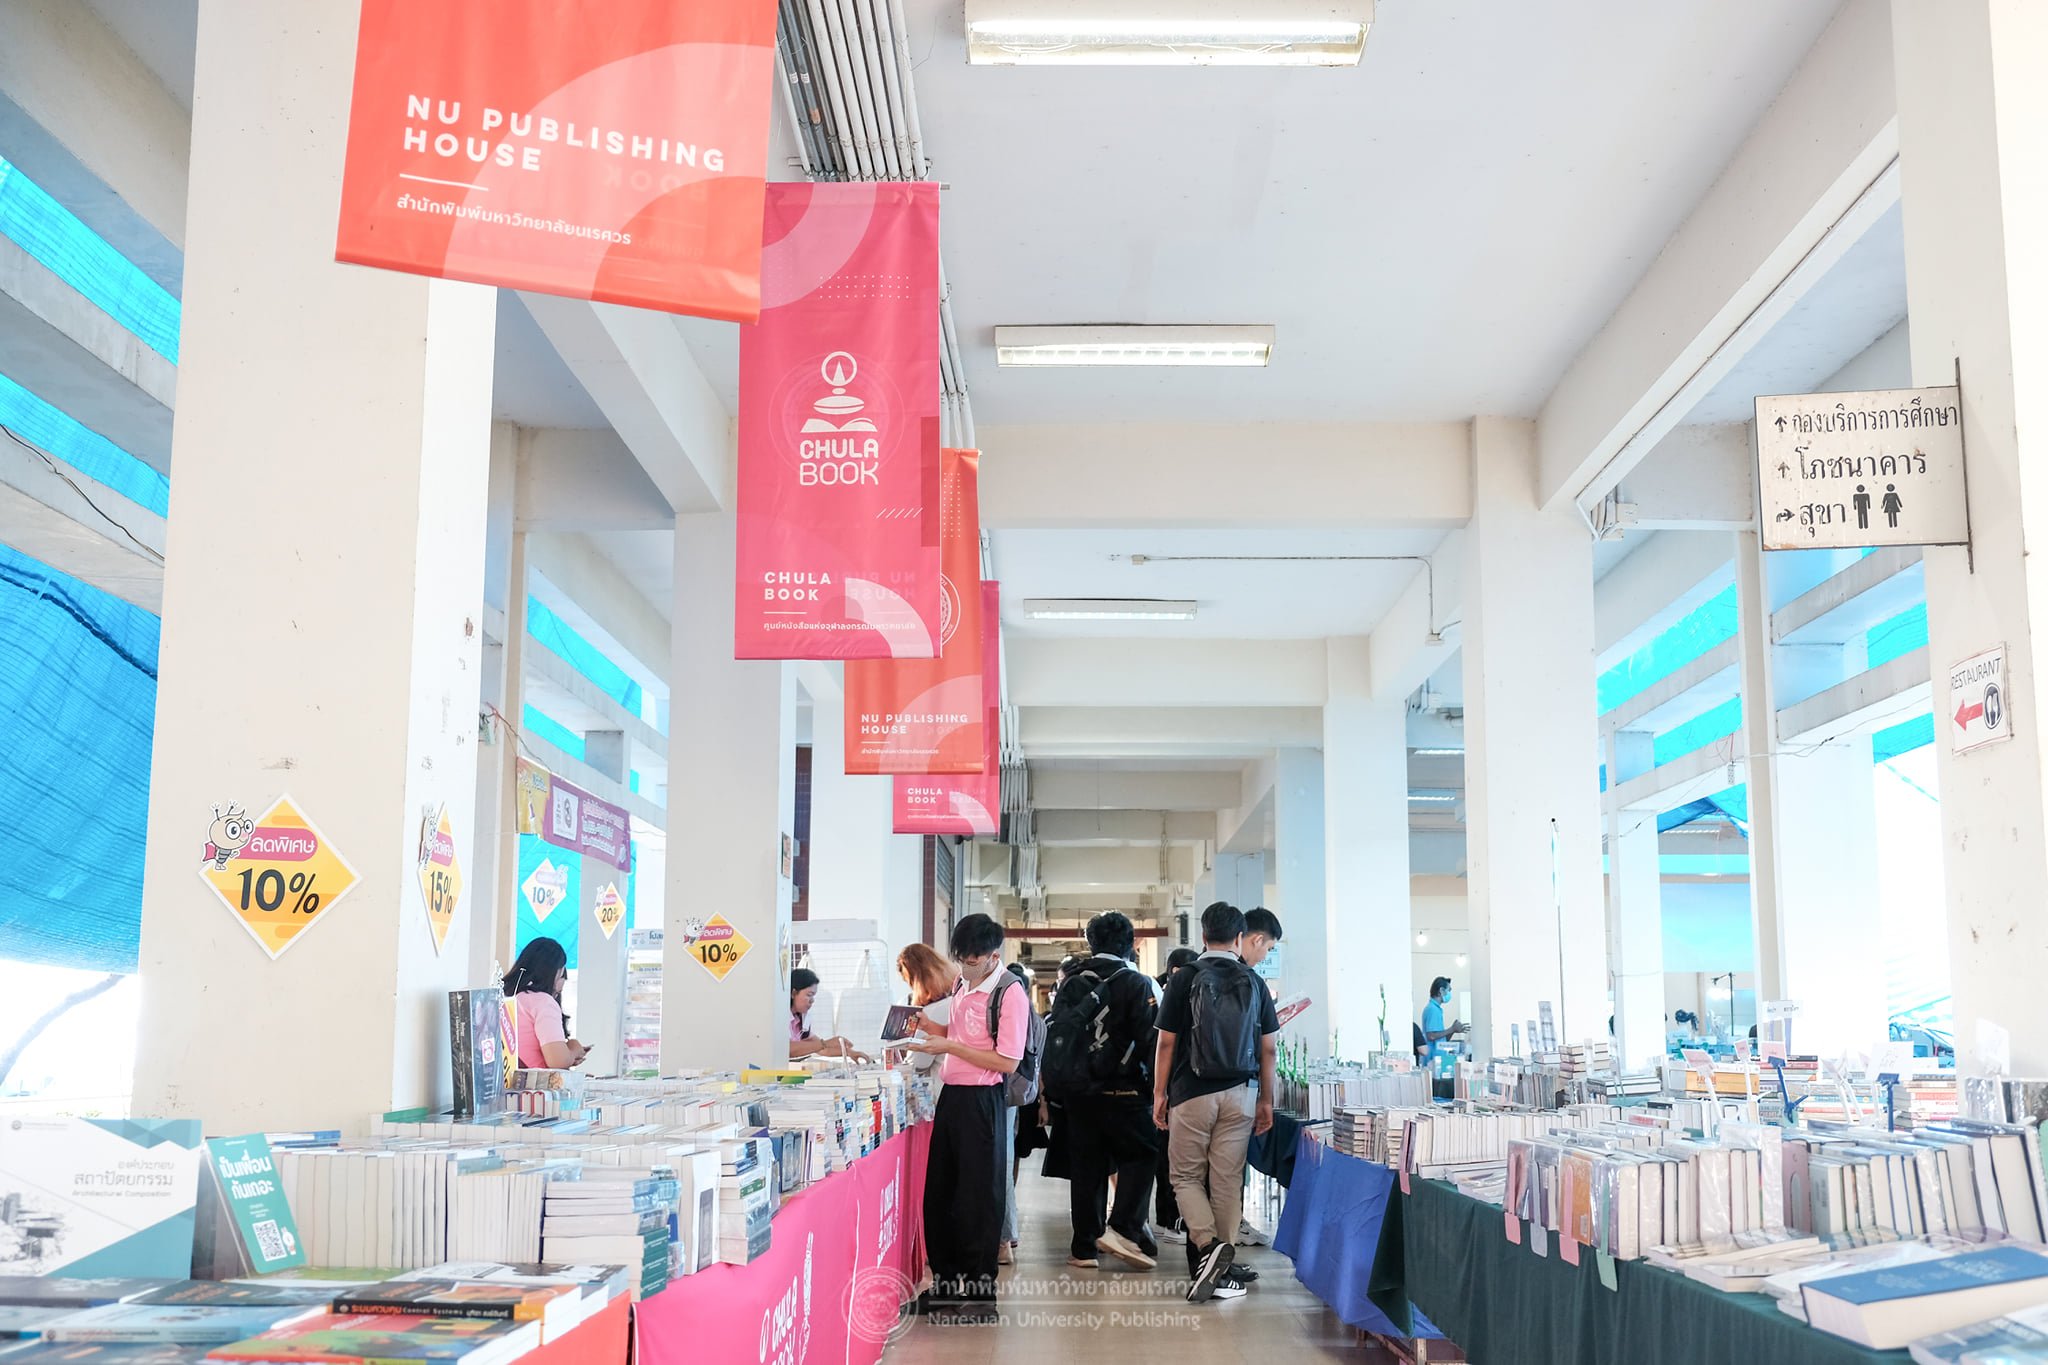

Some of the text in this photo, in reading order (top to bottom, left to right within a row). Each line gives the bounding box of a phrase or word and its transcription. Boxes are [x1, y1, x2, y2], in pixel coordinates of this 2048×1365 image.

[406, 95, 726, 173] NU PUBLISHING
[403, 127, 542, 172] HOUSE
[396, 193, 632, 246] สำนักพิมพ์มหาวิทยาลัยนเรศวร
[1791, 396, 1959, 432] กองบริการการศึกษา
[799, 438, 879, 459] CHULA
[1794, 446, 1927, 480] โภชนาคาร
[799, 461, 879, 486] BOOK
[1799, 502, 1846, 538] สุขา
[764, 571, 832, 585] CHULA
[764, 588, 820, 600] BOOK
[1951, 657, 2002, 690] RESTAURANT
[861, 714, 969, 723] NU PUBLISHING
[861, 725, 907, 734] HOUSE
[907, 787, 943, 795] CHULA
[907, 796, 937, 804] BOOK
[251, 836, 316, 854] ลดพิเศษ
[237, 868, 320, 914] 10%
[430, 871, 453, 915] 15%
[532, 887, 555, 906] 10%
[601, 908, 620, 923] 20%
[700, 944, 737, 964] 10%
[218, 1149, 273, 1178] เป็นเพื่อน
[74, 1170, 173, 1186] สถาปัตยกรรม
[125, 1189, 171, 1198] Composition
[231, 1180, 275, 1200] กันเถอะ
